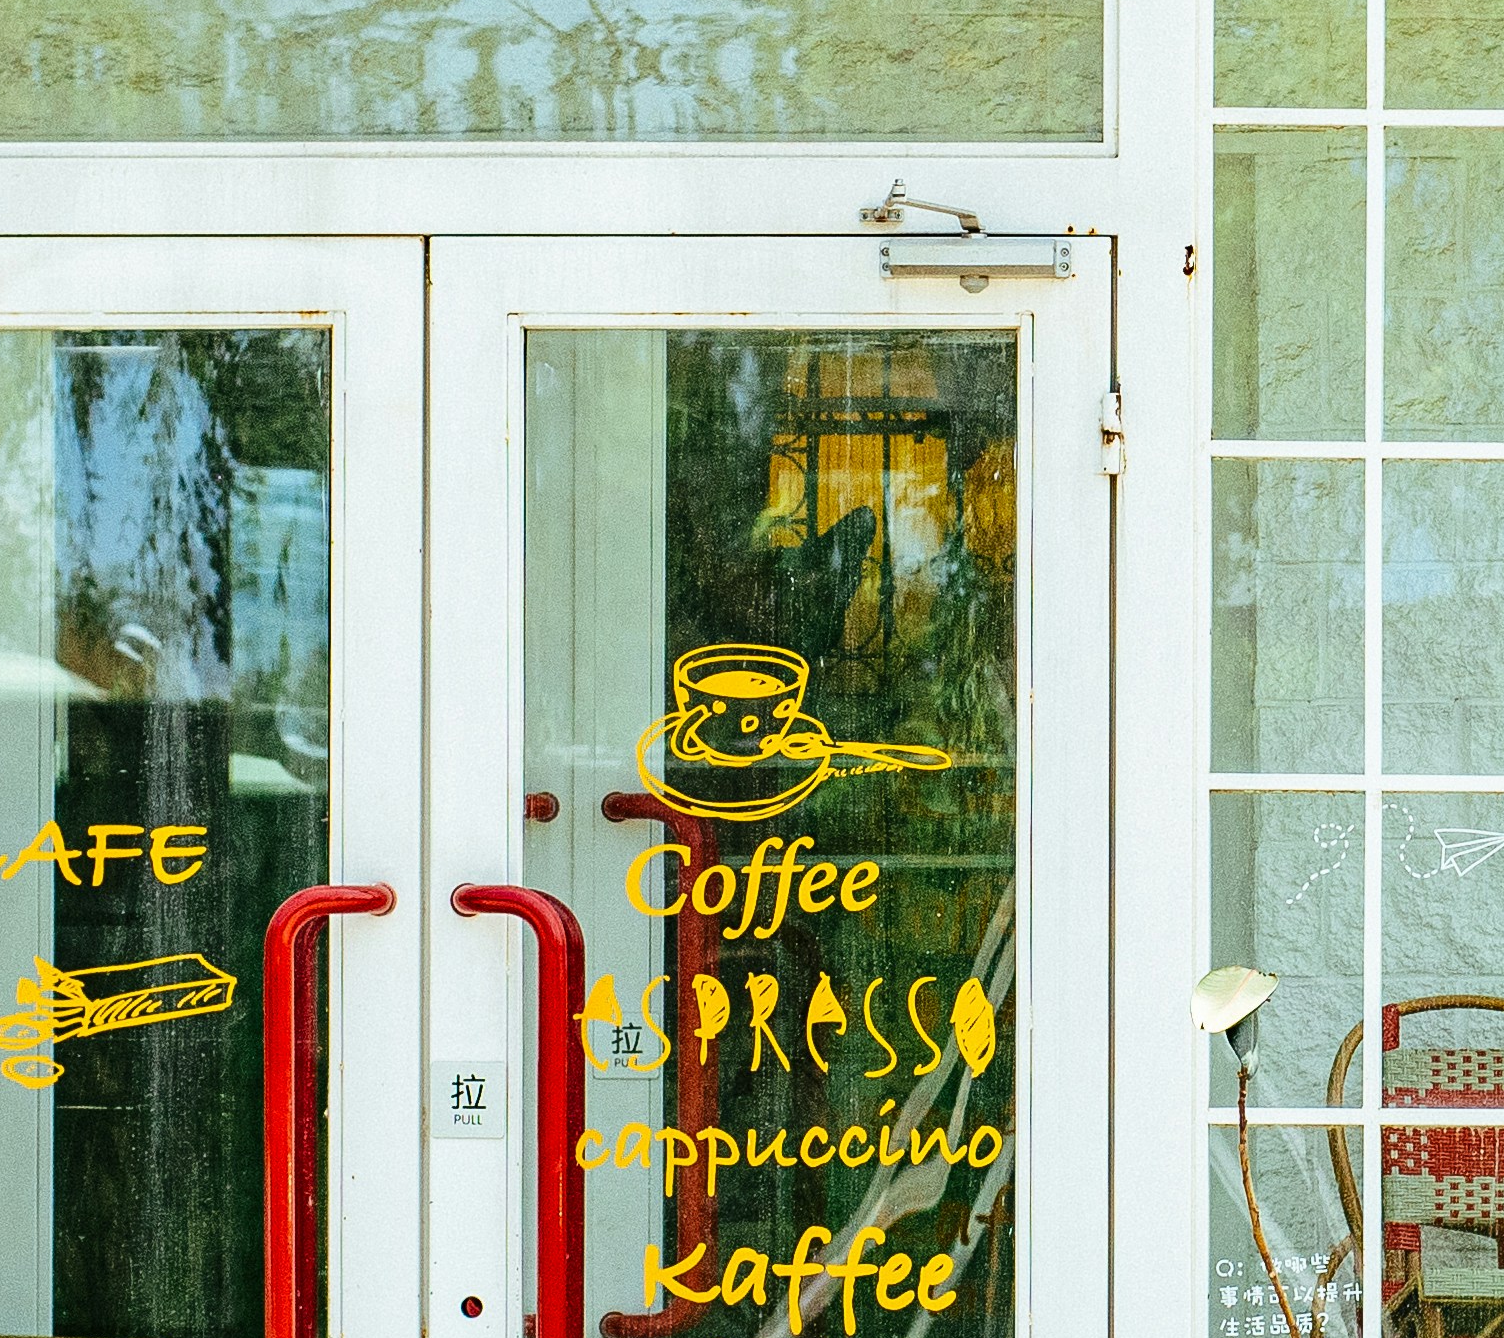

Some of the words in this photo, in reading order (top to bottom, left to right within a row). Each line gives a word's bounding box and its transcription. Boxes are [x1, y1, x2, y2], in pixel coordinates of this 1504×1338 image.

[626, 836, 880, 940] Coffee
[611, 1022, 643, 1055] 拉
[450, 1073, 487, 1110] 拉
[453, 1114, 483, 1126] PULL
[575, 1099, 1003, 1197] cappuccino
[644, 1224, 957, 1335] Kaffee
